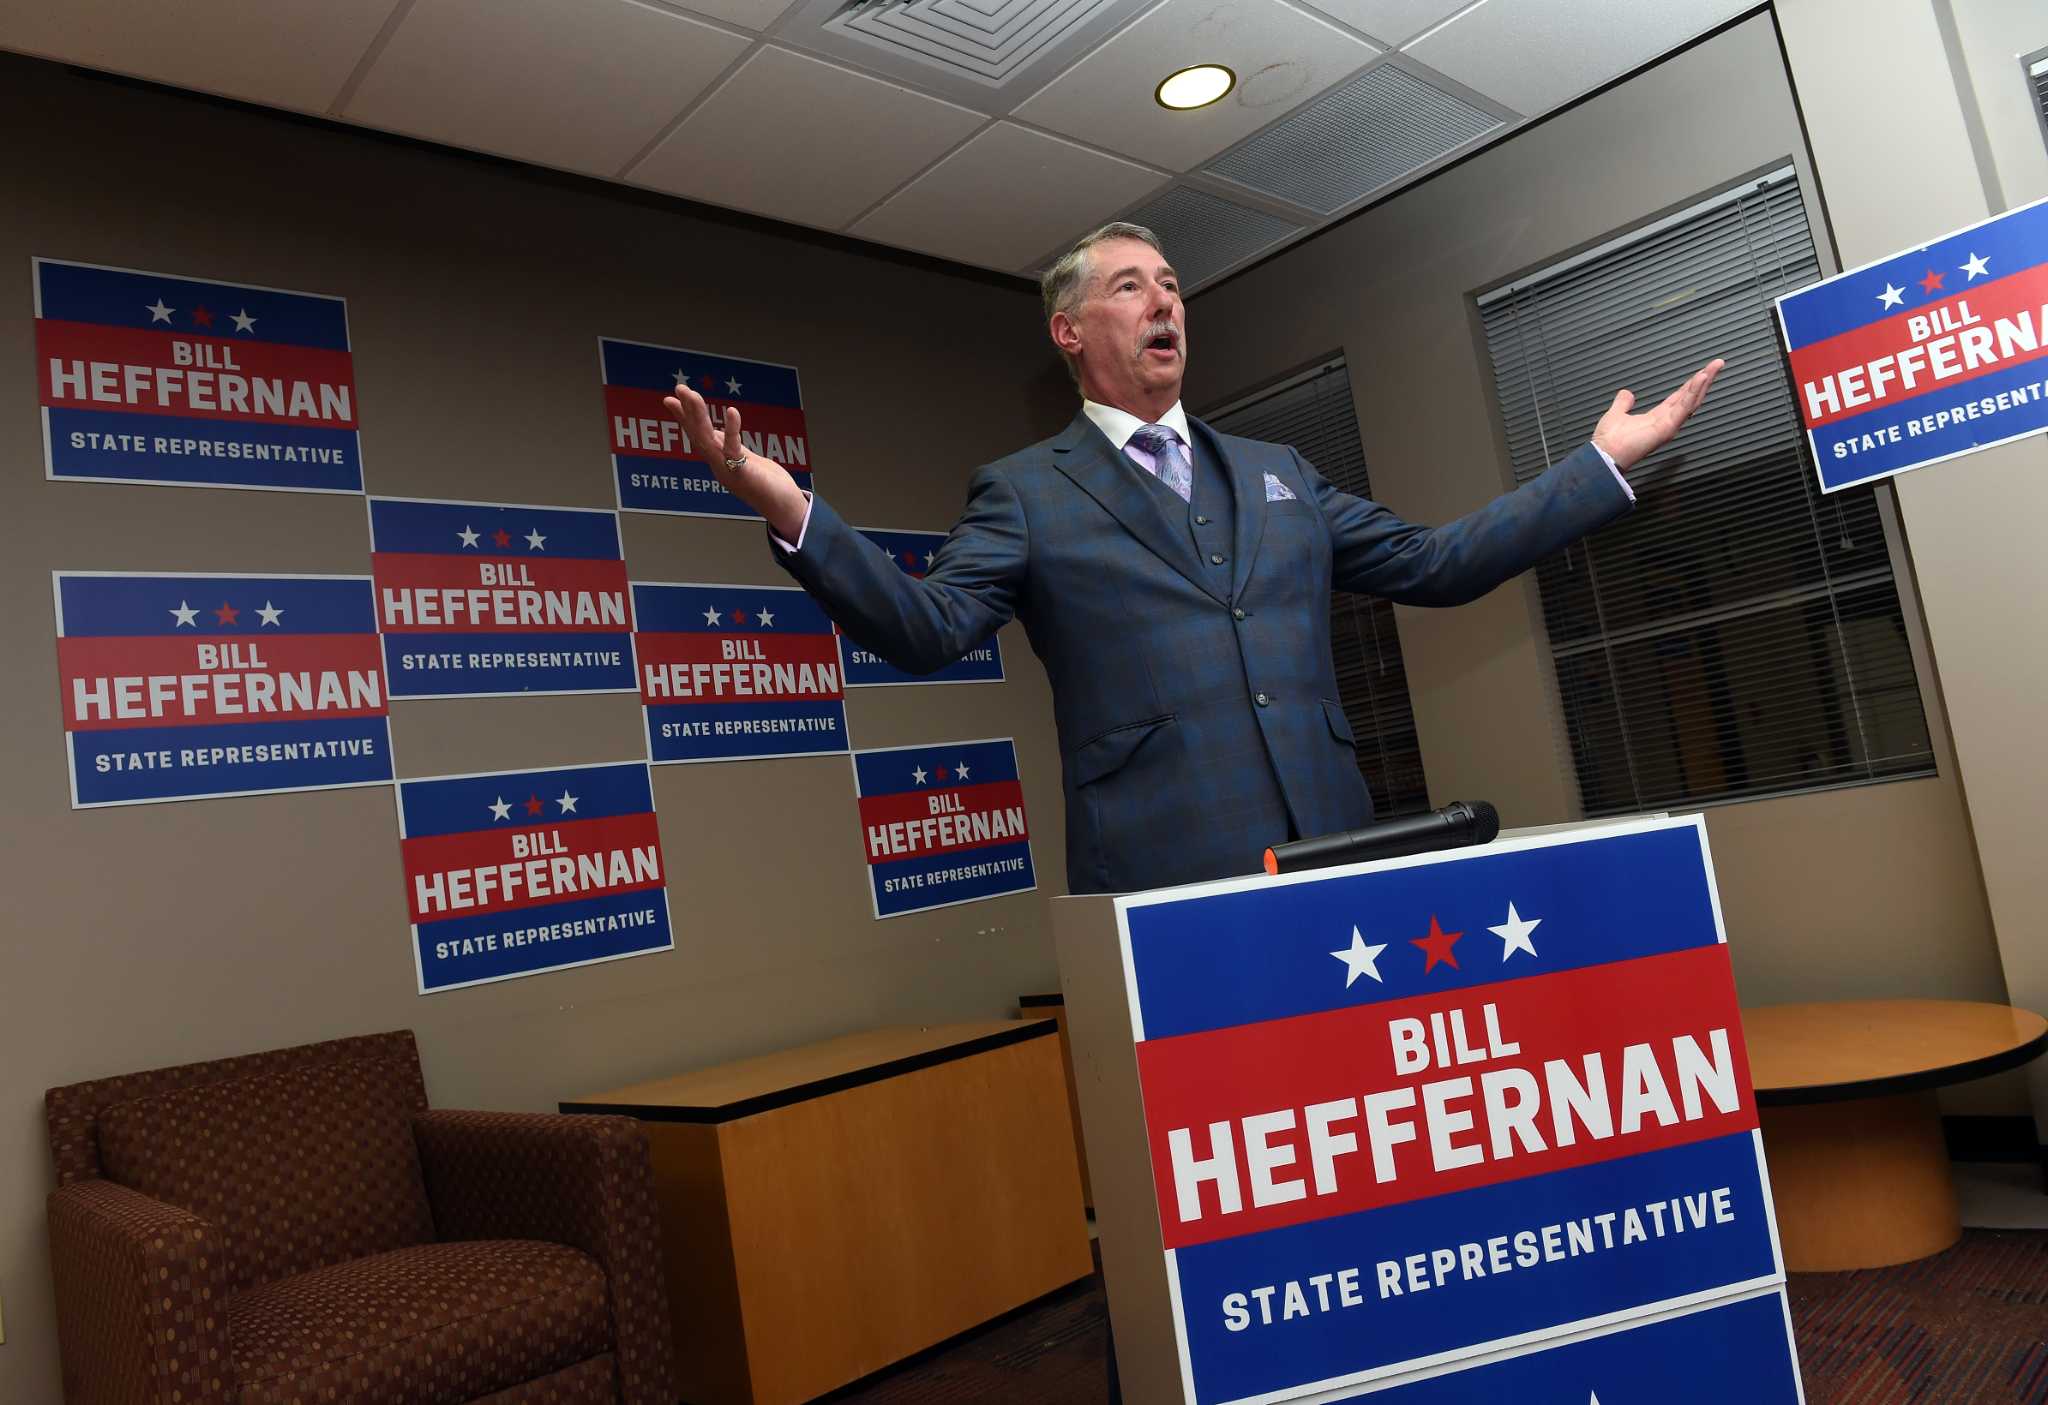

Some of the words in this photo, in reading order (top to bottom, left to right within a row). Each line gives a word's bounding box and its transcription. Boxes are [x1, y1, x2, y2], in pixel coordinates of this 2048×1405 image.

[1907, 300, 1982, 343] BILL
[172, 341, 241, 371] BILL
[1804, 303, 2048, 419] HEFFERN
[49, 357, 352, 422] HEFFERNAN
[1833, 425, 1903, 459] STATE
[1906, 379, 2048, 437] REPRESENT
[70, 431, 147, 453] STATE
[153, 437, 344, 465] REPRESENTATIVE
[613, 414, 808, 467] HEFNAN
[630, 473, 679, 490] STATE
[479, 563, 536, 587] BILL
[382, 587, 626, 625] HEFFERNAN
[197, 643, 268, 670] BILL
[401, 653, 463, 670] STATE
[468, 651, 621, 669] REPRESENTATIVE
[721, 639, 767, 661] BILL
[850, 651, 888, 666] STA
[72, 670, 381, 721] HEFFERNAN
[644, 663, 839, 698] HEFFERNAN
[661, 721, 711, 738] STATE
[714, 717, 836, 735] REPRESENTATIVE
[95, 750, 173, 773] STATE
[180, 738, 374, 767] REPRESENTATIVE
[927, 792, 965, 815] BILL
[511, 829, 569, 859] BILL
[867, 806, 1025, 857] HEFFERNAN
[414, 845, 660, 914] HEFFERNAN
[884, 874, 925, 893] STATE
[926, 857, 1025, 886] REPRESENTATIVE
[435, 934, 498, 959] STATE
[502, 909, 656, 949] REPRESENTATIVE
[1388, 1002, 1521, 1076] BILL
[1167, 1027, 1741, 1223] HEFFERNAN
[1222, 1267, 1364, 1332] STATE
[1376, 1186, 1735, 1299] REPRESENTATIVE
